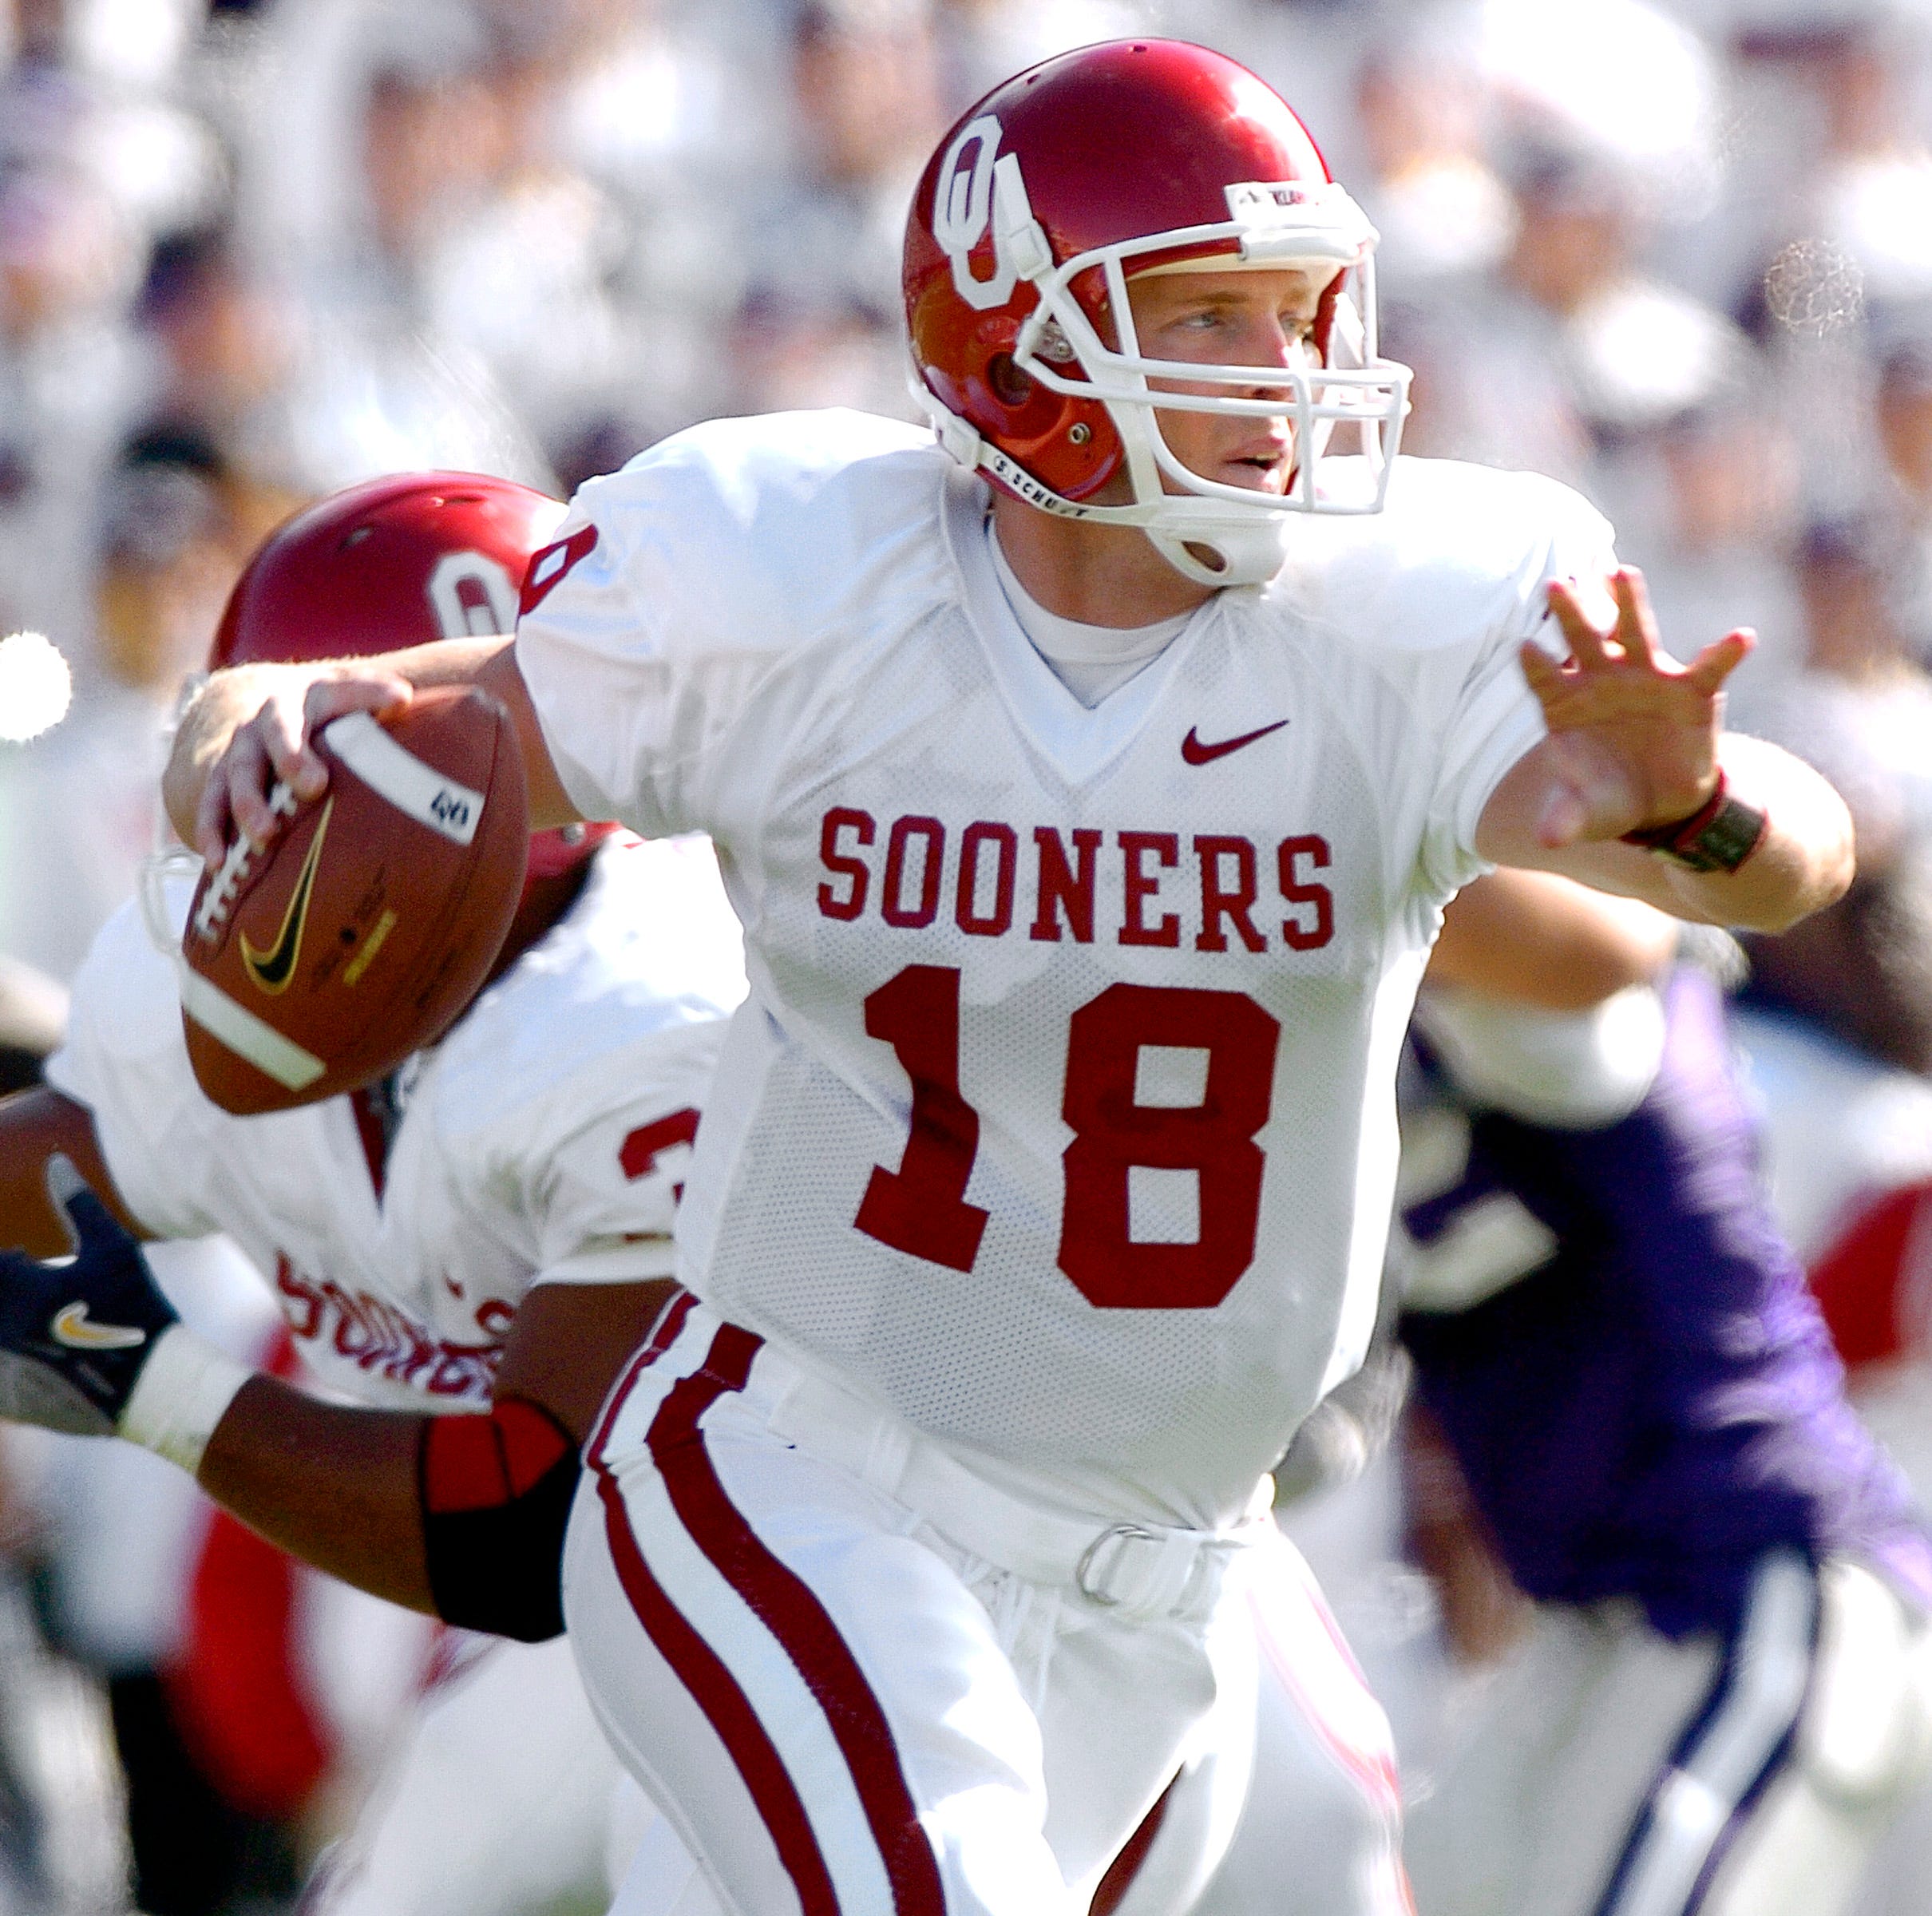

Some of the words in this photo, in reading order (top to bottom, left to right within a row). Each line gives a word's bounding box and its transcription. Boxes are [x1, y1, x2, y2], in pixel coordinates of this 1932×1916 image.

[1012, 473, 1088, 517] SCHUT
[818, 806, 1334, 953] SOONERS
[853, 964, 1281, 1308] 18
